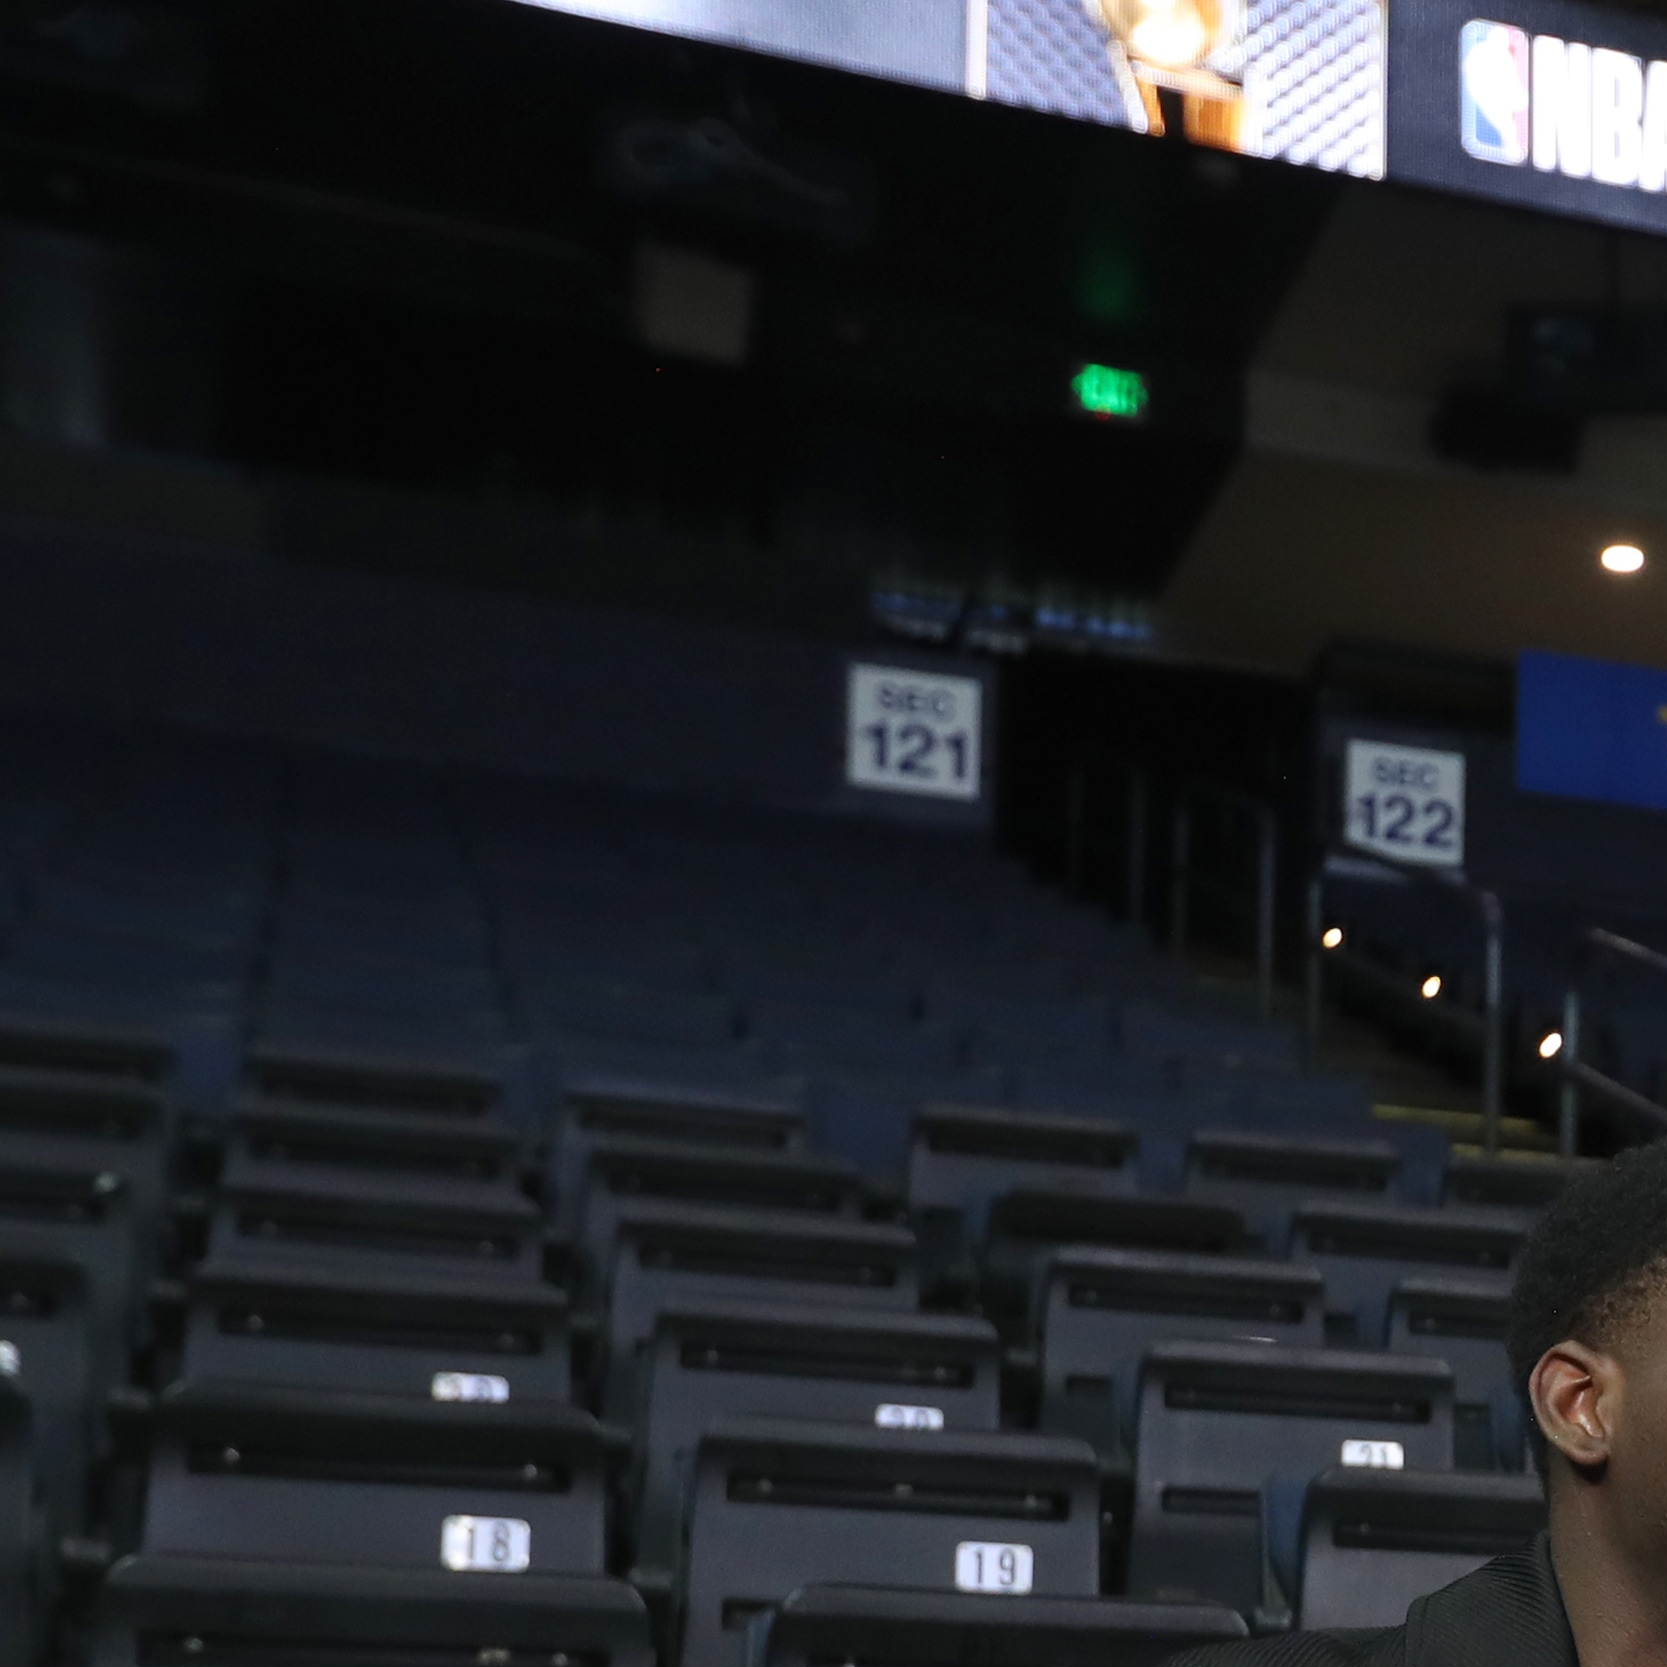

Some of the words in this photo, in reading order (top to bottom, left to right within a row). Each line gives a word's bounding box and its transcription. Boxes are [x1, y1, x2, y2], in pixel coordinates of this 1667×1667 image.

[878, 680, 958, 720] SEC
[861, 721, 968, 781] 121
[1373, 756, 1439, 795] SEC
[1354, 796, 1455, 850] 122
[463, 1522, 513, 1563] 18
[971, 1547, 1015, 1586] 19
